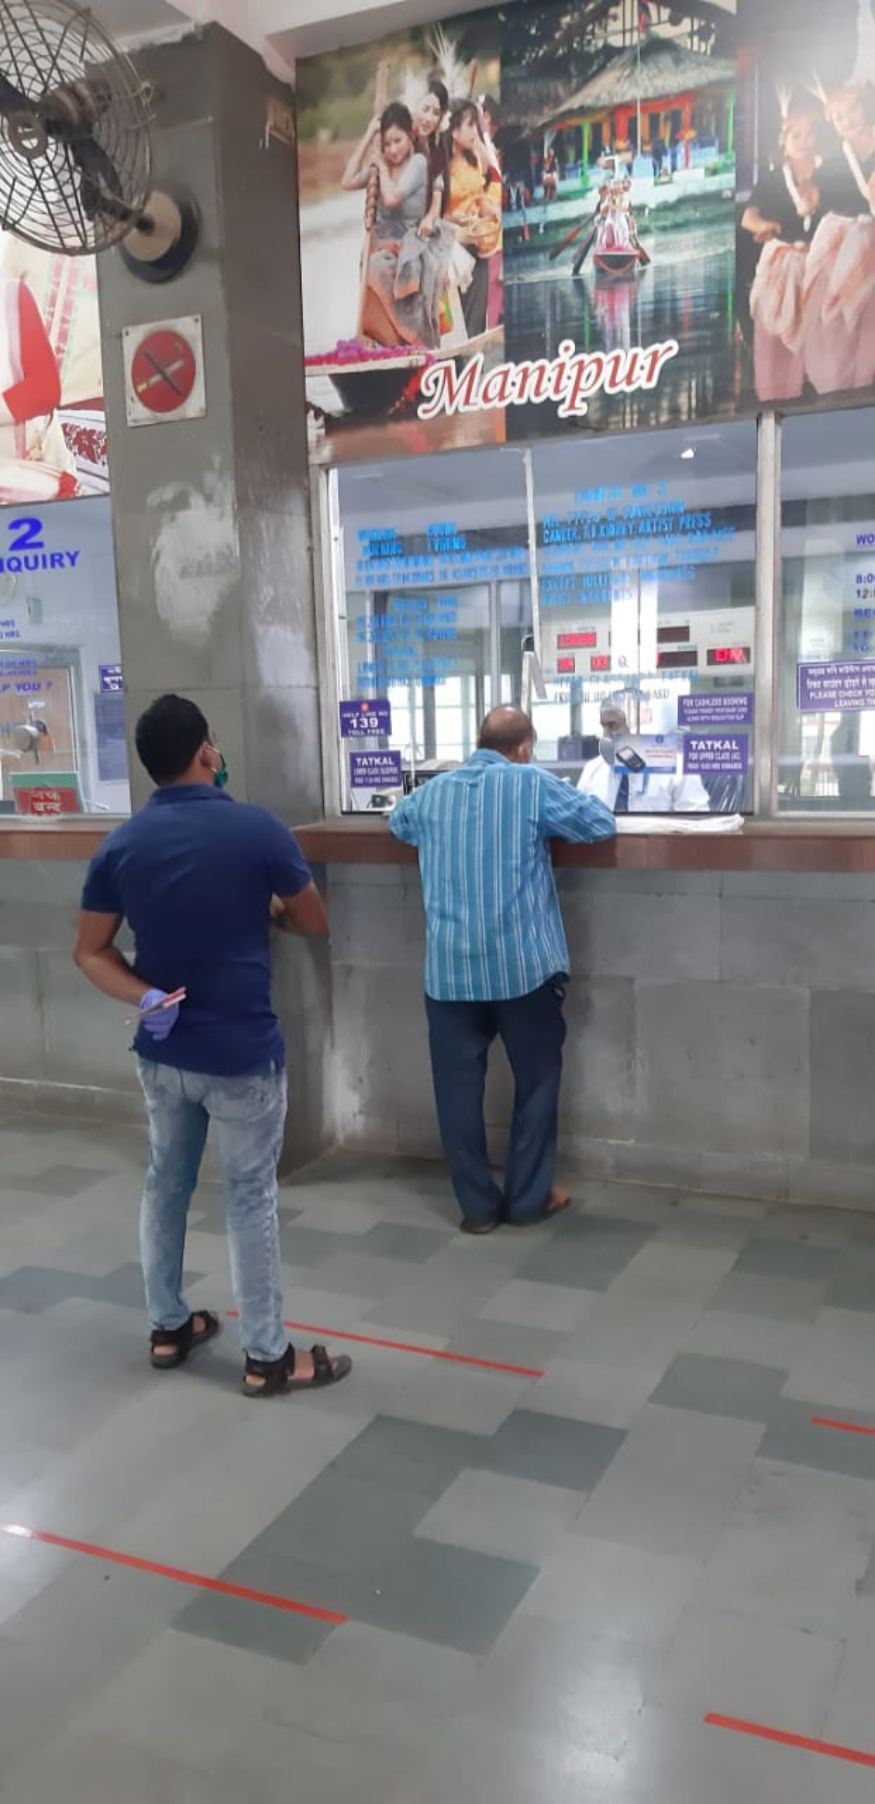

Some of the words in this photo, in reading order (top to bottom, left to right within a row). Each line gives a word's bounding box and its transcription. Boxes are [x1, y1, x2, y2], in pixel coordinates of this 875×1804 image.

[417, 340, 679, 419] Manipur
[8, 517, 45, 551] 2
[16, 681, 41, 693] YOU
[350, 717, 379, 729] 139
[690, 740, 740, 750] TATKAL
[356, 757, 395, 766] TATKAL
